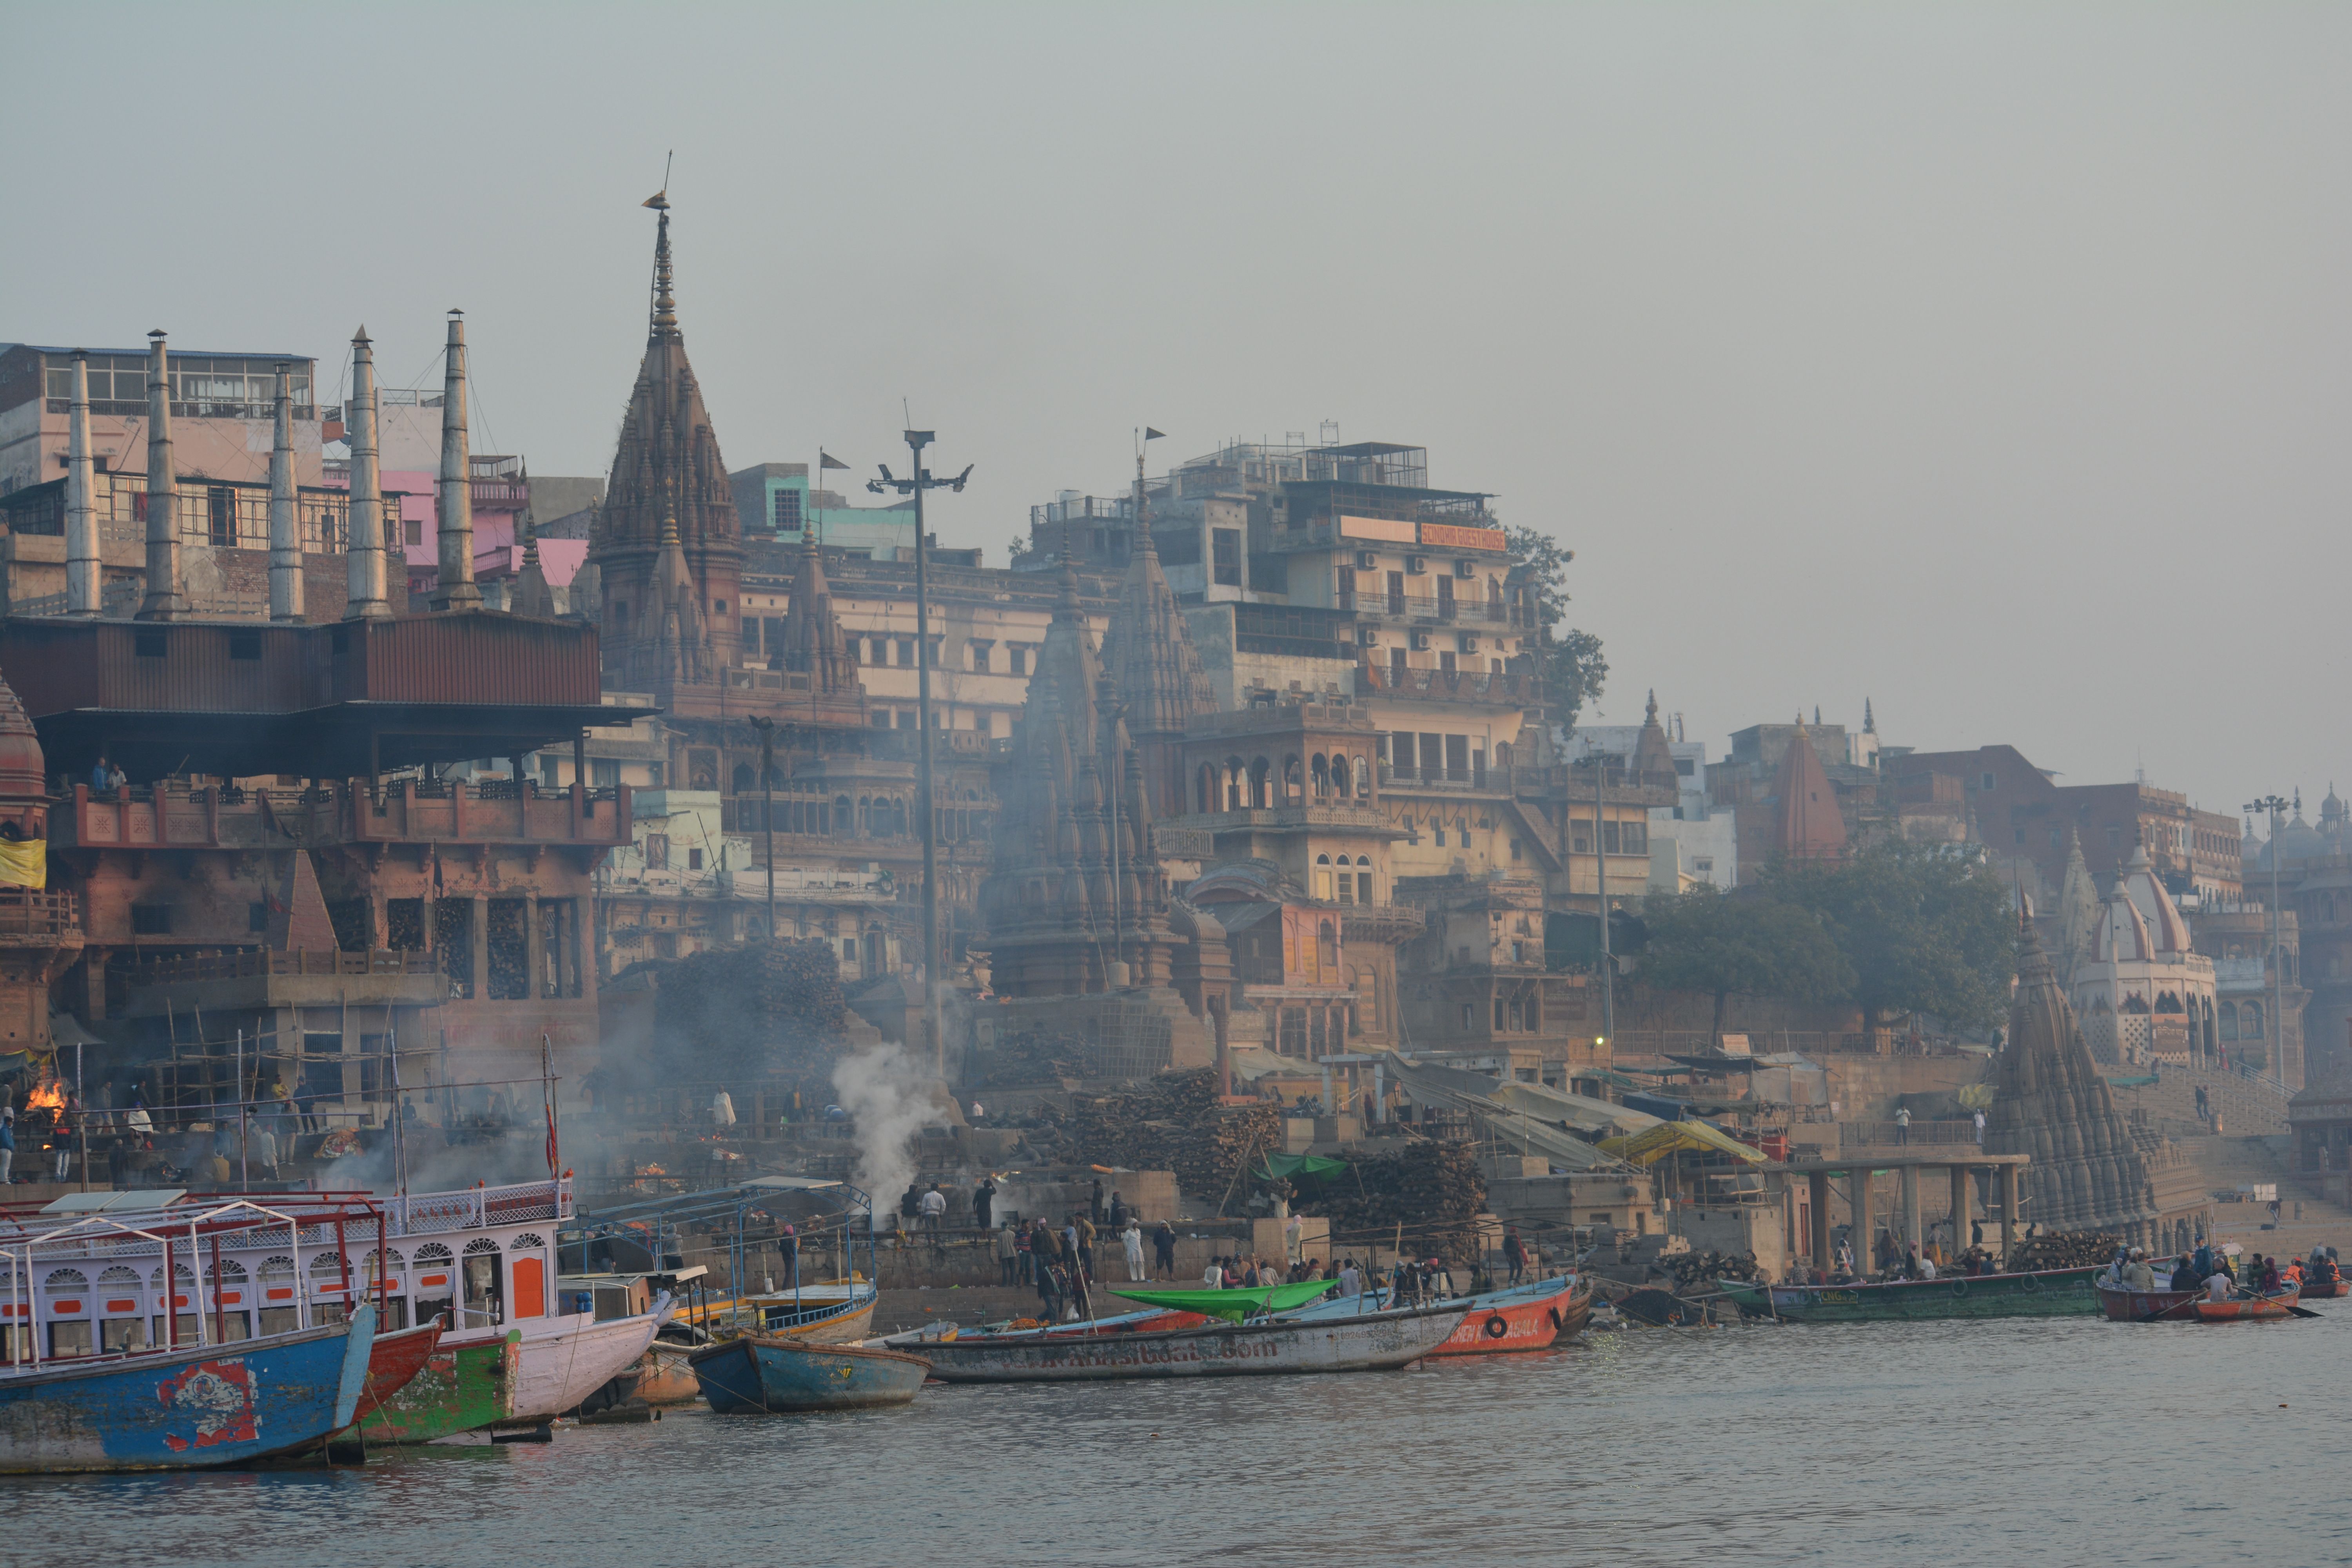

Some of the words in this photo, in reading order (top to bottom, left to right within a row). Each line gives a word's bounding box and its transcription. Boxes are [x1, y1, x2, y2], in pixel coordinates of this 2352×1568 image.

[1458, 528, 1481, 547] GUEST
[1482, 530, 1504, 550] HOUSE
[1821, 1291, 1842, 1301] CNG
[1447, 1323, 1475, 1343] CHEN
[1498, 1318, 1539, 1339] ASALA
